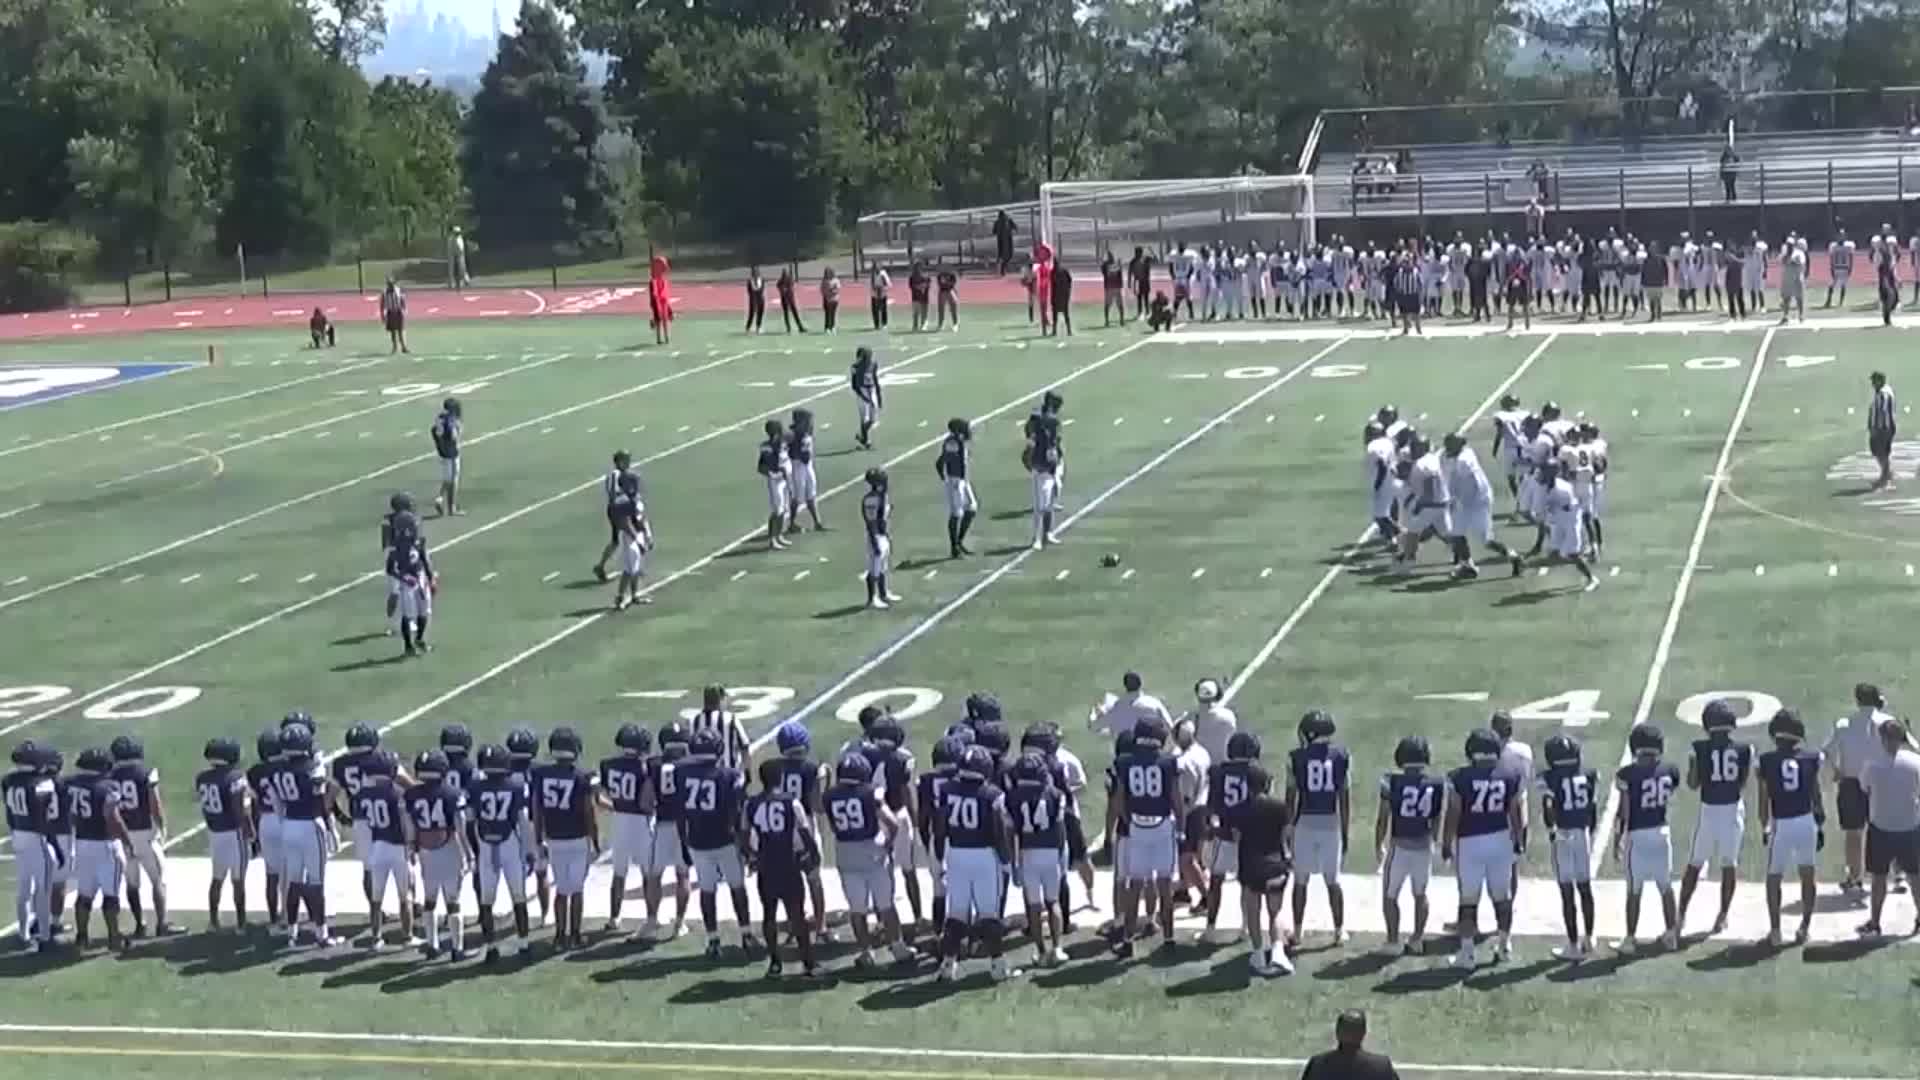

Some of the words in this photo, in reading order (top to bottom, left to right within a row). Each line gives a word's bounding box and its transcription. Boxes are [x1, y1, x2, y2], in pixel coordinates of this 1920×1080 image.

[1510, 690, 1783, 727] 40
[1307, 760, 1335, 792] 81
[1710, 749, 1738, 782] 16
[1782, 759, 1800, 791] 9
[273, 772, 299, 801] 18
[543, 778, 575, 809] 57
[608, 769, 637, 800] 50
[685, 779, 716, 810] 73
[1129, 766, 1163, 798] 88
[1471, 779, 1506, 814] 72
[1561, 776, 1588, 809] 15
[1640, 777, 1673, 808] 26
[68, 786, 92, 818] 75
[361, 799, 389, 829] 30
[415, 798, 447, 829] 34
[480, 791, 513, 821] 37
[753, 801, 784, 832] 46
[831, 799, 865, 831] 59
[947, 796, 978, 829] 70
[1021, 799, 1049, 833] 14
[1400, 786, 1434, 818] 24
